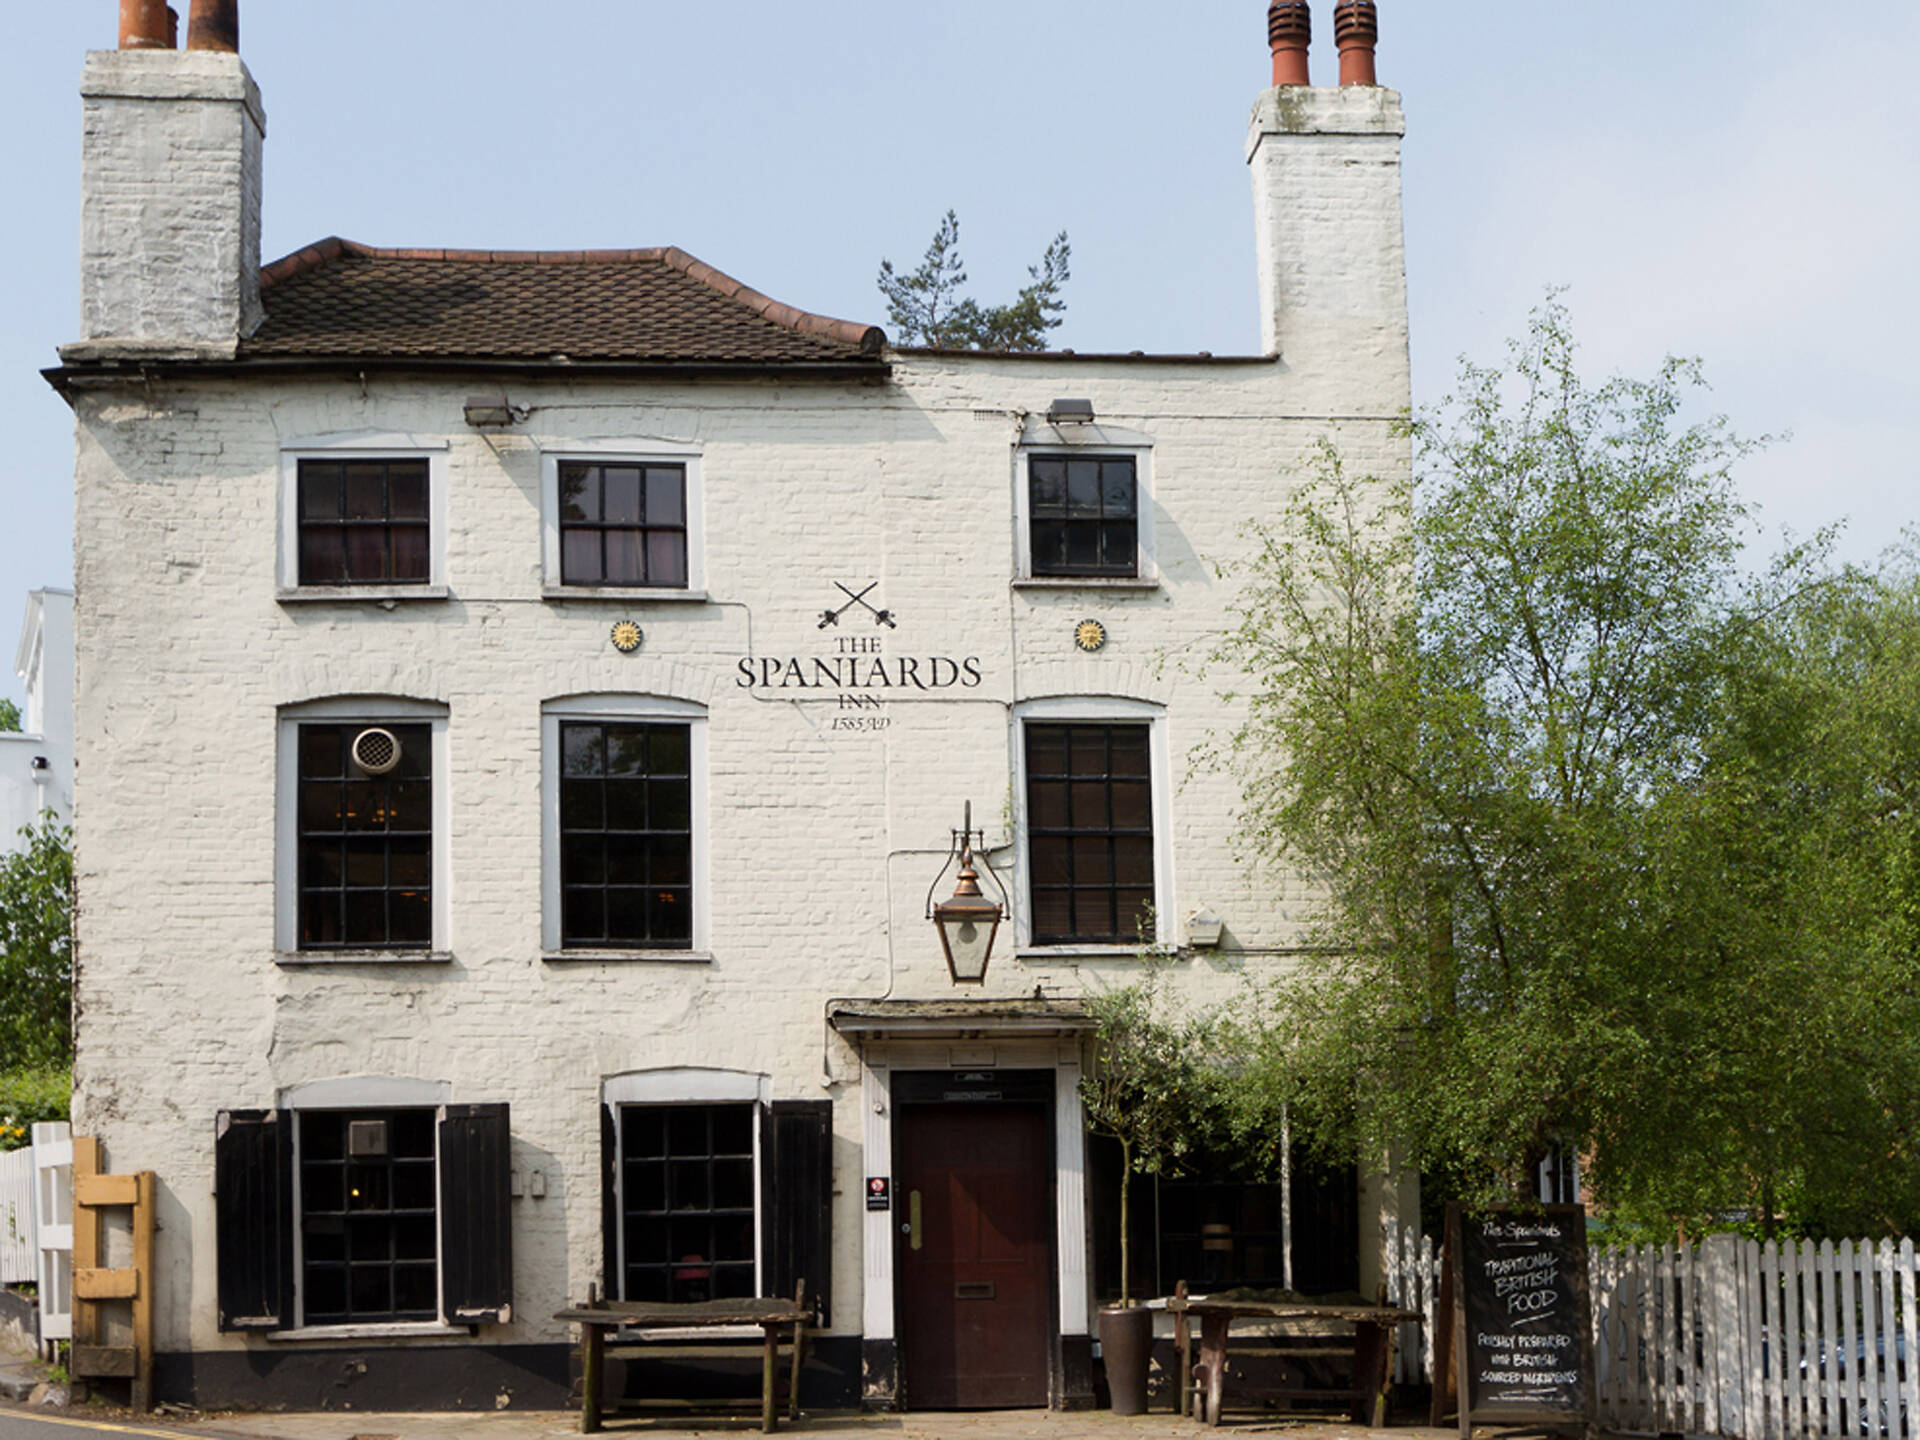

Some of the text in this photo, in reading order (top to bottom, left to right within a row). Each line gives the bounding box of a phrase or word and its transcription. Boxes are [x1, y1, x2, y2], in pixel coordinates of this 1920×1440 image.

[834, 636, 882, 653] THE
[736, 656, 983, 691] SPANIARDS
[837, 694, 881, 710] INN
[1483, 1251, 1560, 1277] TRADITIONAL
[1494, 1267, 1559, 1297] BRITISH
[1507, 1289, 1559, 1315] FOOD
